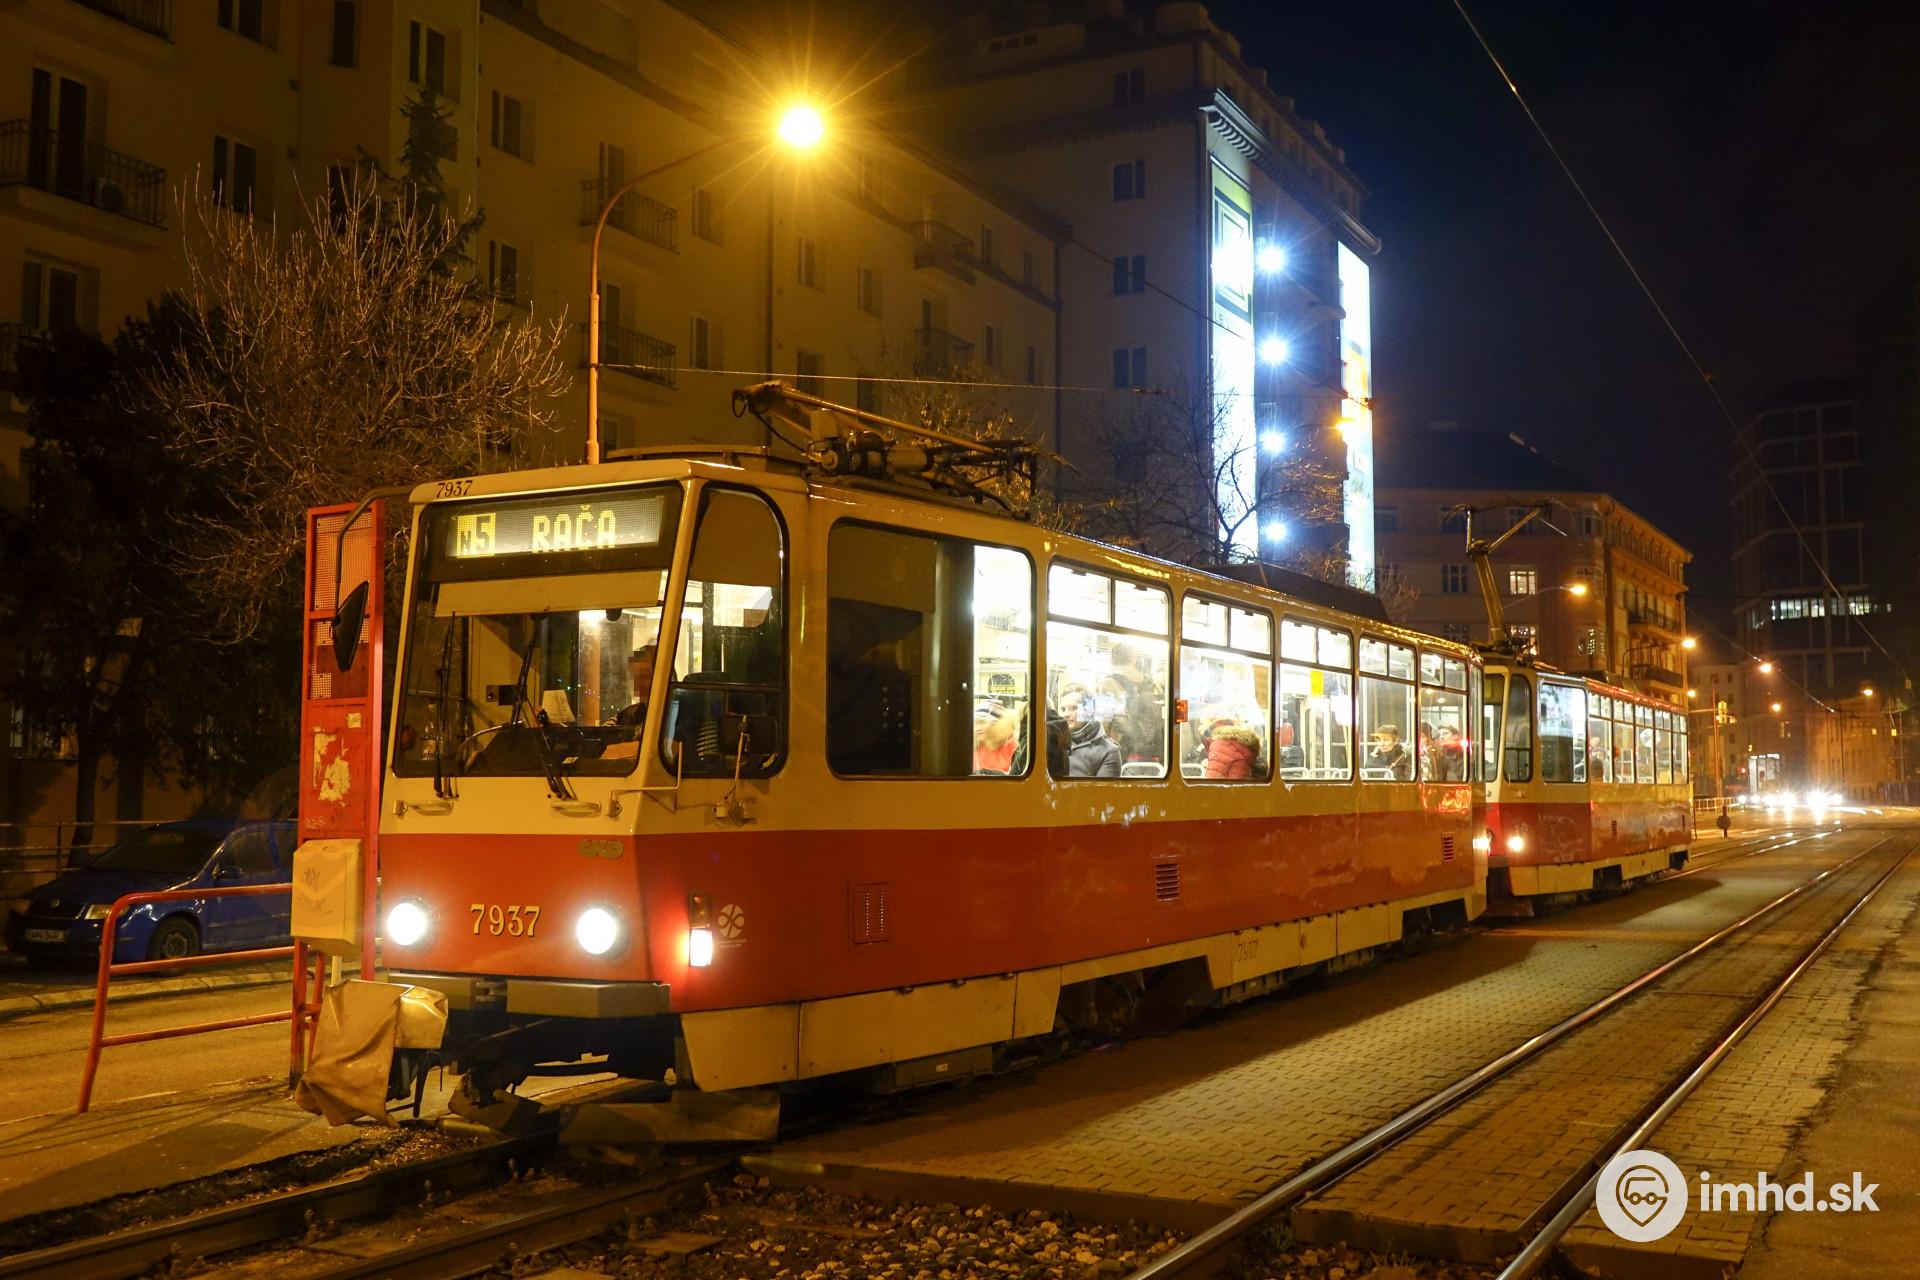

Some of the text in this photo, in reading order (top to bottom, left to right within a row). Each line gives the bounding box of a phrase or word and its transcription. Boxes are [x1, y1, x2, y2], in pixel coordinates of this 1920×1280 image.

[436, 480, 473, 498] 7937
[460, 504, 616, 553] N5 RAČA
[470, 903, 541, 937] 7937
